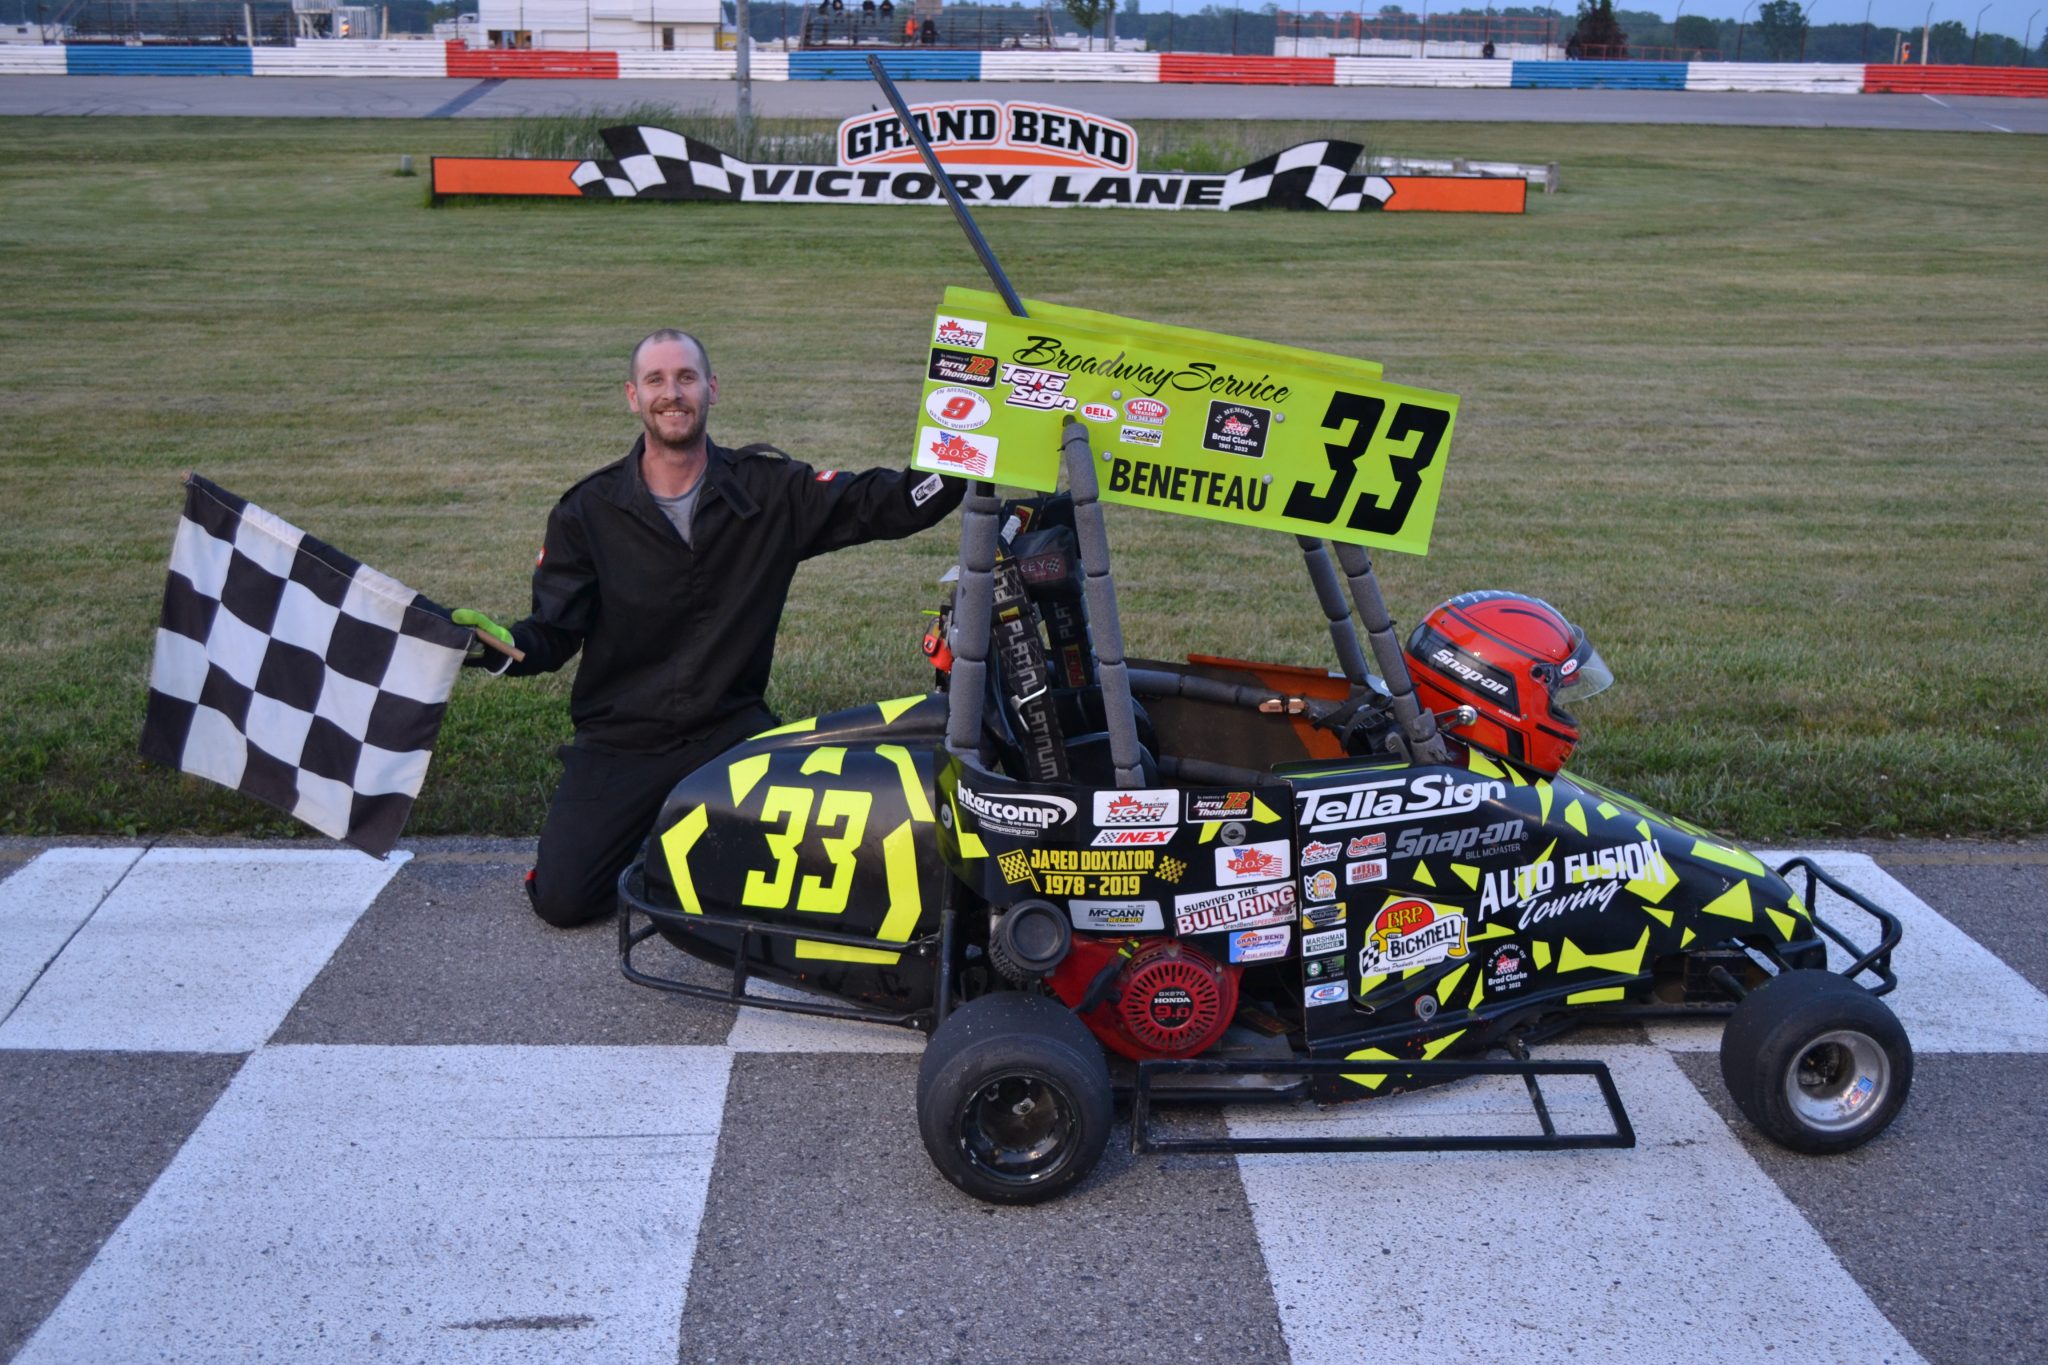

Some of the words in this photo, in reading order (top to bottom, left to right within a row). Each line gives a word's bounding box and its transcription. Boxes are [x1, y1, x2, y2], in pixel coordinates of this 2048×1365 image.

[847, 107, 997, 161] GRAND
[1012, 110, 1129, 166] BEND
[752, 169, 1033, 201] VICTORY
[1048, 175, 1225, 207] LANE
[939, 329, 980, 343] JCAR
[936, 359, 967, 372] Jerry
[939, 368, 991, 383] Thompson
[965, 355, 995, 376] 72
[1012, 335, 1174, 397] Broadway
[1172, 363, 1293, 404] Service
[1001, 363, 1071, 392] Tella
[941, 396, 976, 420] 9
[1005, 384, 1078, 412] Sign
[1132, 401, 1163, 413] ACTION
[1085, 406, 1113, 418] BELL
[1214, 414, 1223, 424] IN
[1223, 407, 1254, 419] MEMORY
[1252, 418, 1260, 429] OF
[1211, 432, 1232, 443] Brad
[1231, 436, 1258, 447] Clarke
[1281, 390, 1451, 535] 33
[1108, 458, 1268, 512] BENETEAU
[1432, 648, 1509, 696] Snap-on
[957, 779, 1060, 829] Intercomp
[1193, 800, 1224, 809] Jerry
[1222, 791, 1251, 809] 72
[1296, 778, 1407, 826] Tella
[1404, 773, 1507, 814] Sign
[1108, 805, 1165, 818] JCAR
[1198, 808, 1248, 817] Thompson
[1115, 831, 1171, 844] INEX
[1390, 819, 1524, 860] Snap-on
[741, 785, 873, 914] 33
[1031, 849, 1079, 871] JARED
[1081, 849, 1155, 871] DOXTATOR
[1465, 850, 1481, 860] BILL
[1045, 875, 1086, 895] 1978
[1099, 875, 1141, 896] 2019
[1478, 860, 1555, 922] AUTO
[1563, 839, 1667, 886] FUSION
[1176, 903, 1238, 935] BULL
[1238, 885, 1297, 919] RING
[1177, 907, 1181, 915] I
[1183, 893, 1235, 914] SURVIVED
[1238, 887, 1259, 898] THE
[1516, 880, 1622, 930] Towing
[1236, 935, 1263, 945] GRAND
[1306, 932, 1345, 945] MARSHMAN
[1310, 940, 1340, 951] ENGINES
[1390, 920, 1459, 958] BICKNELL
[1488, 975, 1505, 986] Brad
[1505, 970, 1528, 982] Clarke
